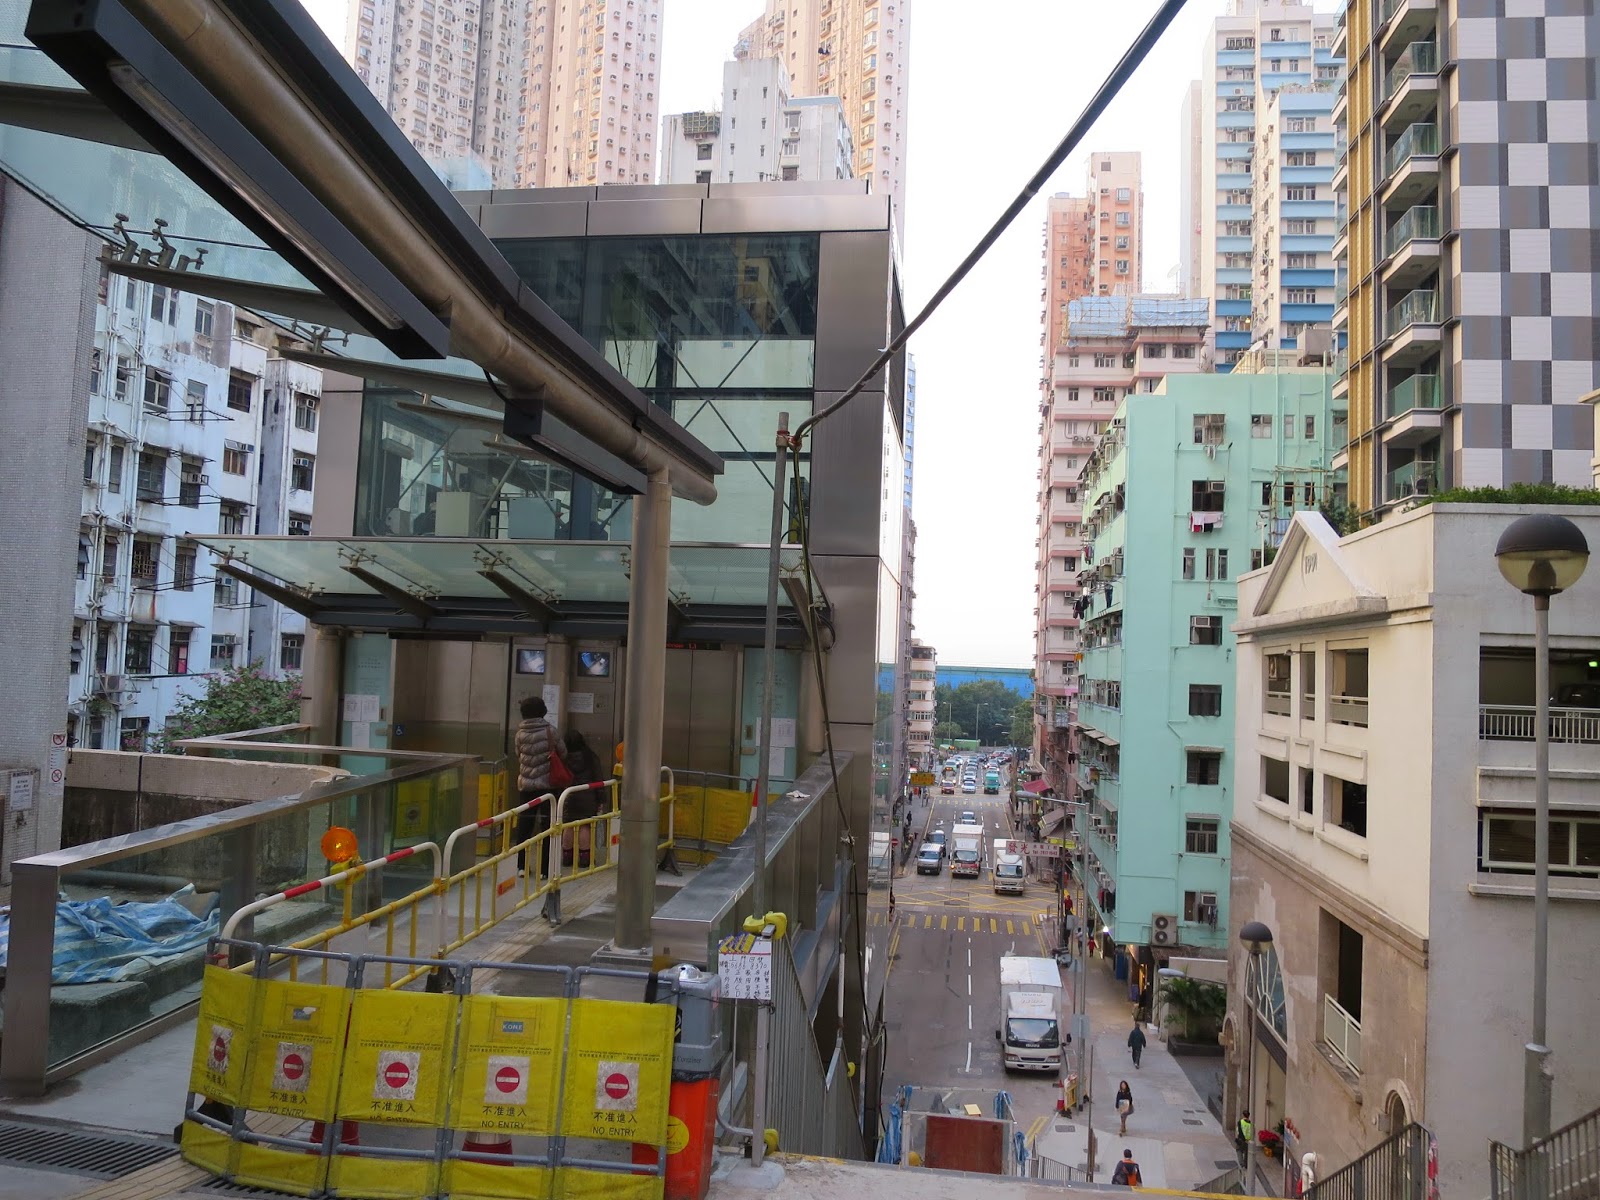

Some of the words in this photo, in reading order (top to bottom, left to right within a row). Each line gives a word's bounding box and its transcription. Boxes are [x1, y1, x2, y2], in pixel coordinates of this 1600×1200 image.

[1008, 841, 1030, 854] 發光
[269, 1091, 308, 1105] 不准進入
[267, 1105, 279, 1114] NO
[281, 1107, 306, 1118] ENTRY
[370, 1101, 416, 1113] 不准進入
[482, 1105, 527, 1117] 不准進入
[593, 1112, 638, 1124] 不准進入
[481, 1120, 494, 1128] NO
[498, 1121, 525, 1130] ENTRY
[592, 1126, 605, 1134] NO
[608, 1127, 636, 1137] ENTRY
